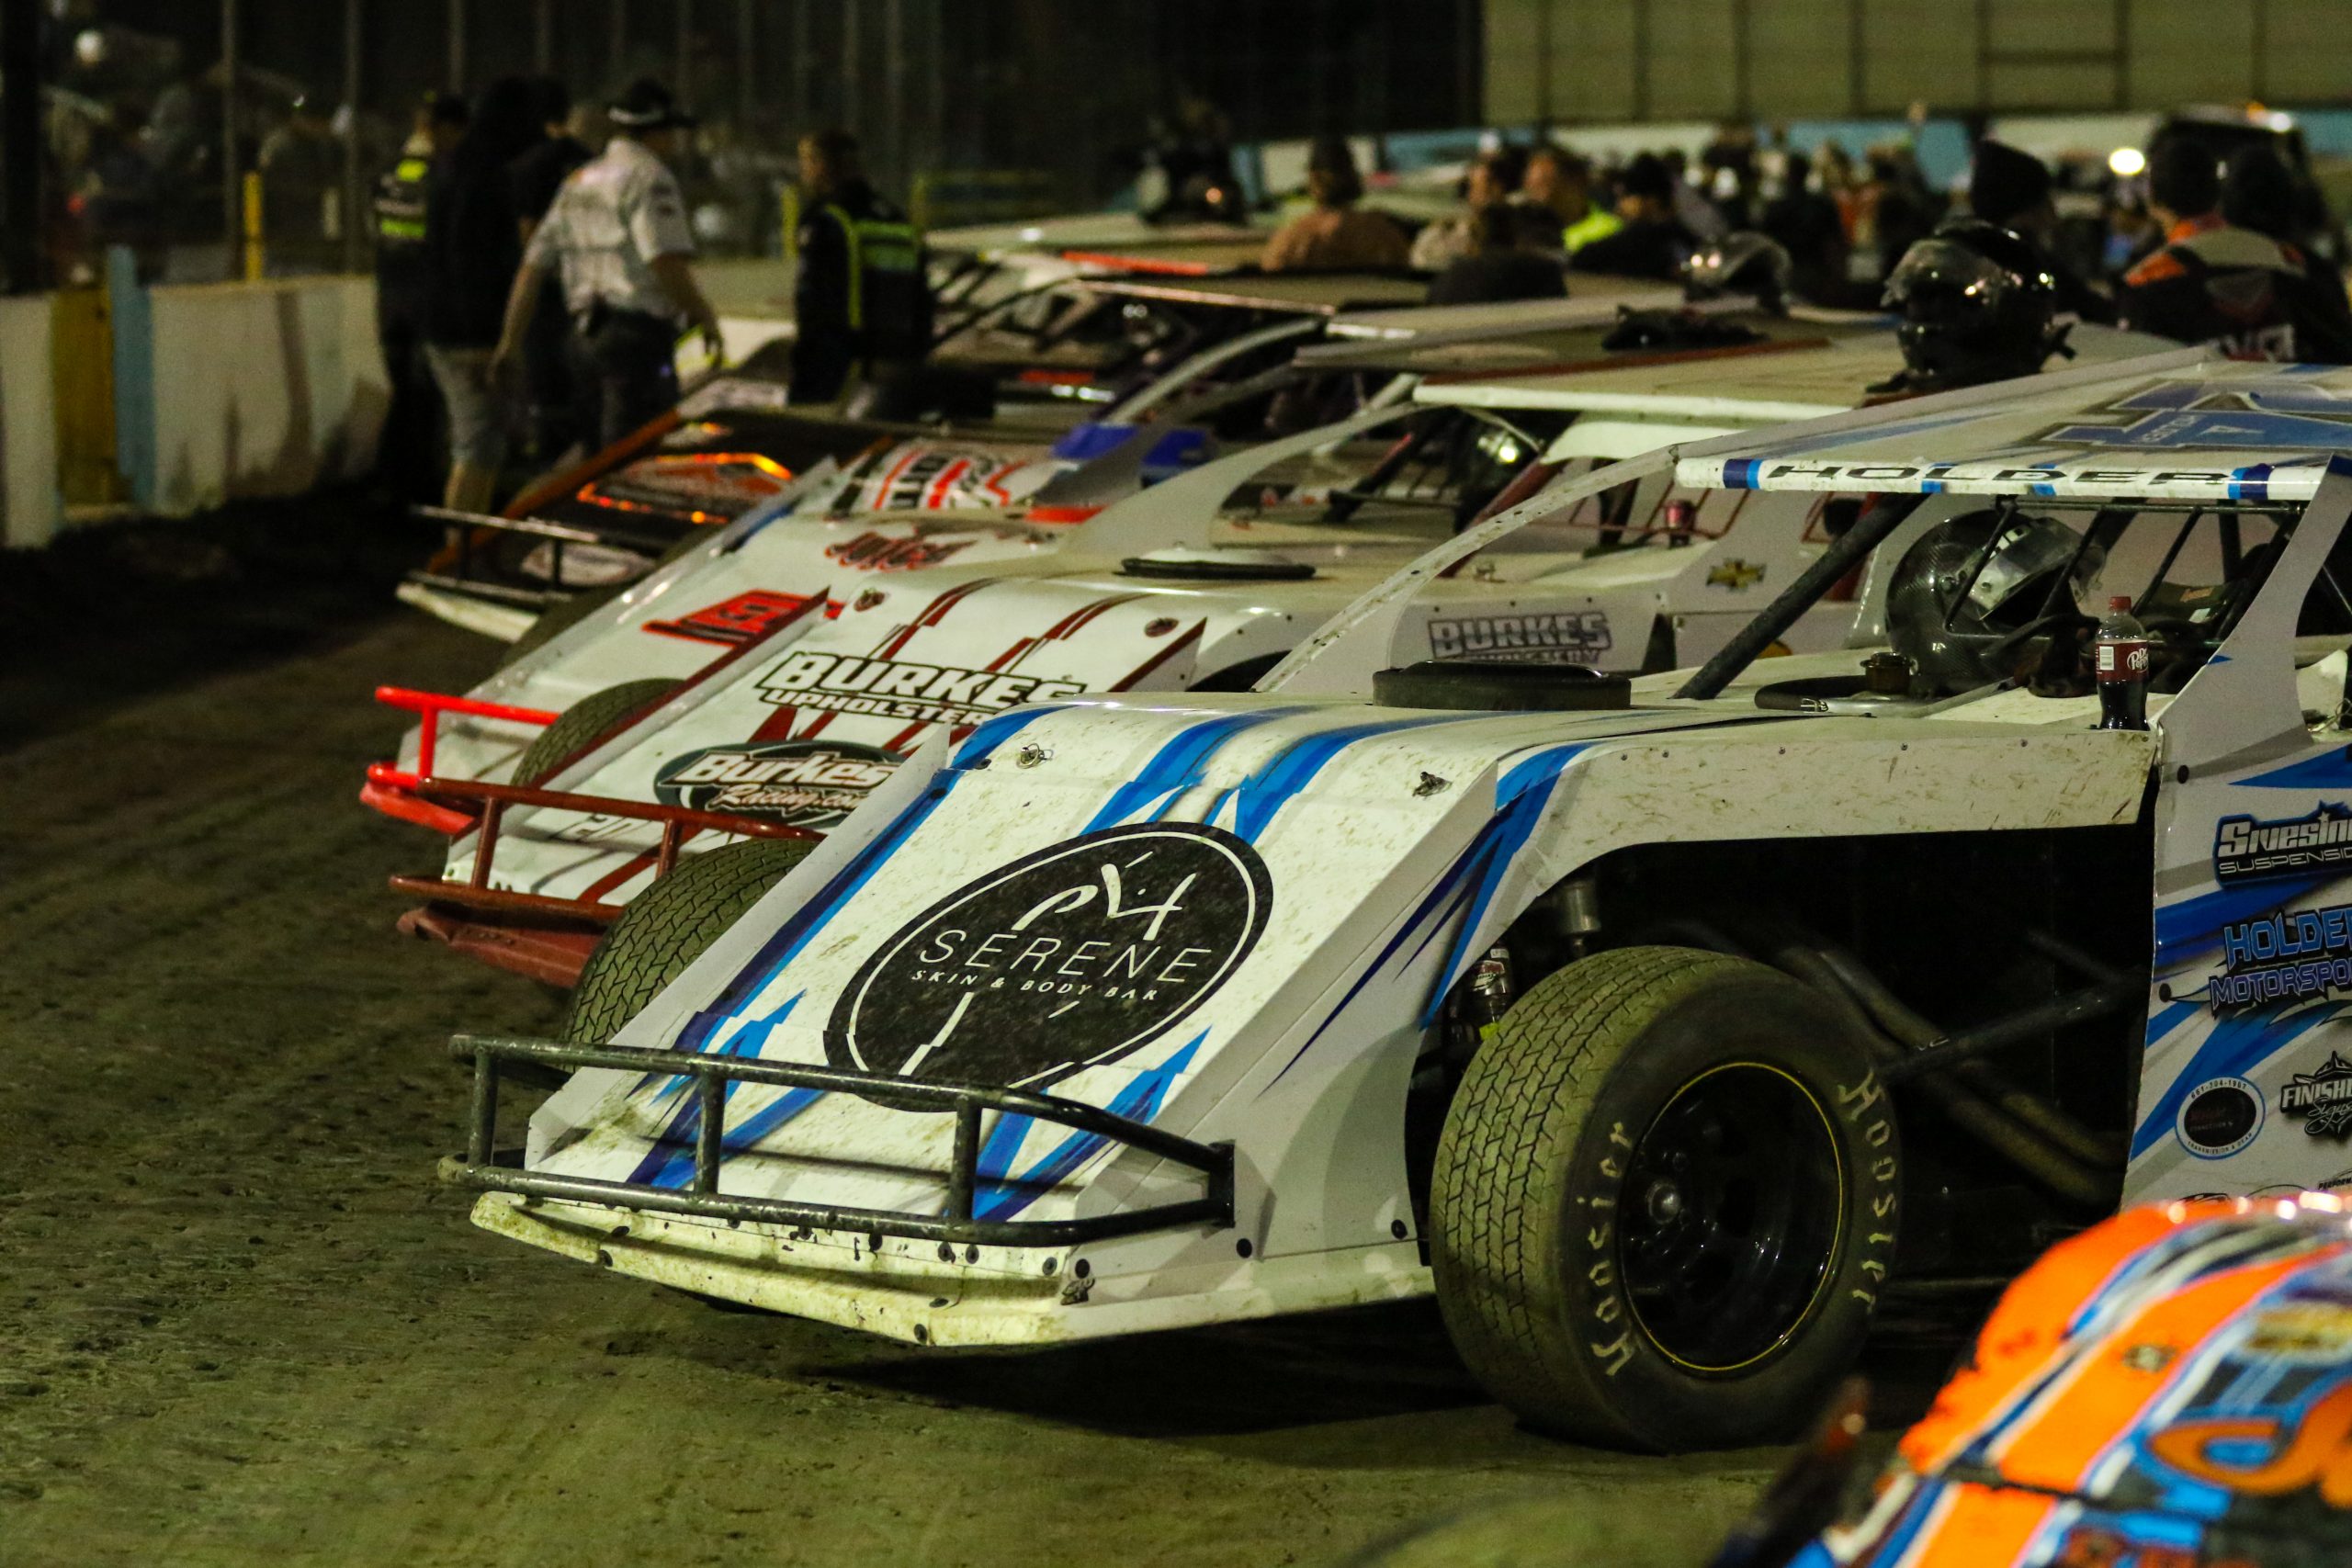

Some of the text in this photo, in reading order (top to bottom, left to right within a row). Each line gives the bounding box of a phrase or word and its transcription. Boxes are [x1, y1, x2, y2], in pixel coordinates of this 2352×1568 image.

[1767, 463, 2233, 486] HOLDER
[1428, 611, 1612, 659] BURKES
[759, 688, 993, 727] UPHOLSTER
[658, 750, 902, 789] Burkes
[2217, 817, 2352, 858] Sivesin
[919, 928, 1213, 984] SERENE
[910, 969, 1160, 1001] SKIN & BODY BAR
[2210, 957, 2352, 1011] MOTORSPO
[1576, 1119, 1643, 1378] Hoosier
